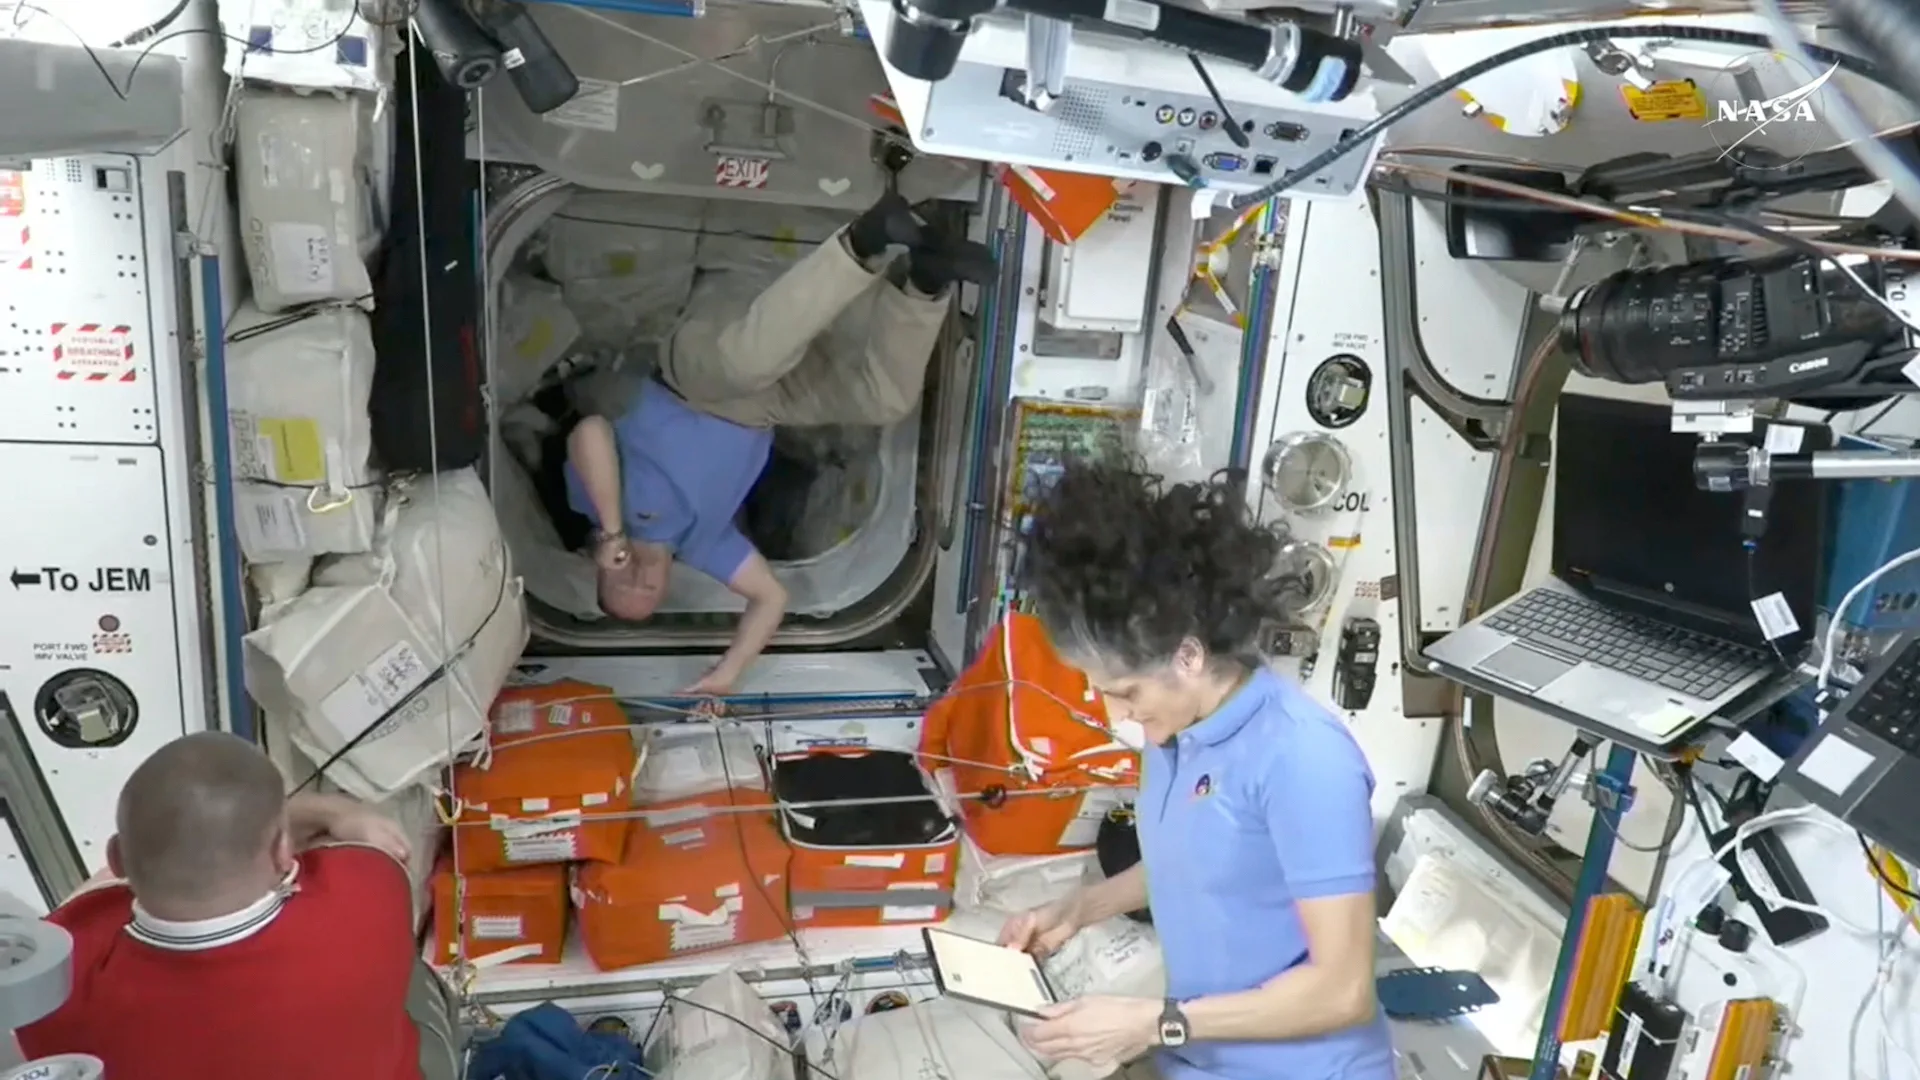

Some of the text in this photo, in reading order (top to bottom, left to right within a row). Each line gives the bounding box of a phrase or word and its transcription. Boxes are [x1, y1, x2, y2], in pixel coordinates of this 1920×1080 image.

[725, 157, 761, 177] EXIT
[1789, 357, 1829, 374] Canon
[1332, 492, 1370, 512] COL
[41, 566, 151, 592] To JEM
[33, 643, 88, 651] PORT FWD
[55, 653, 88, 661] VALVE
